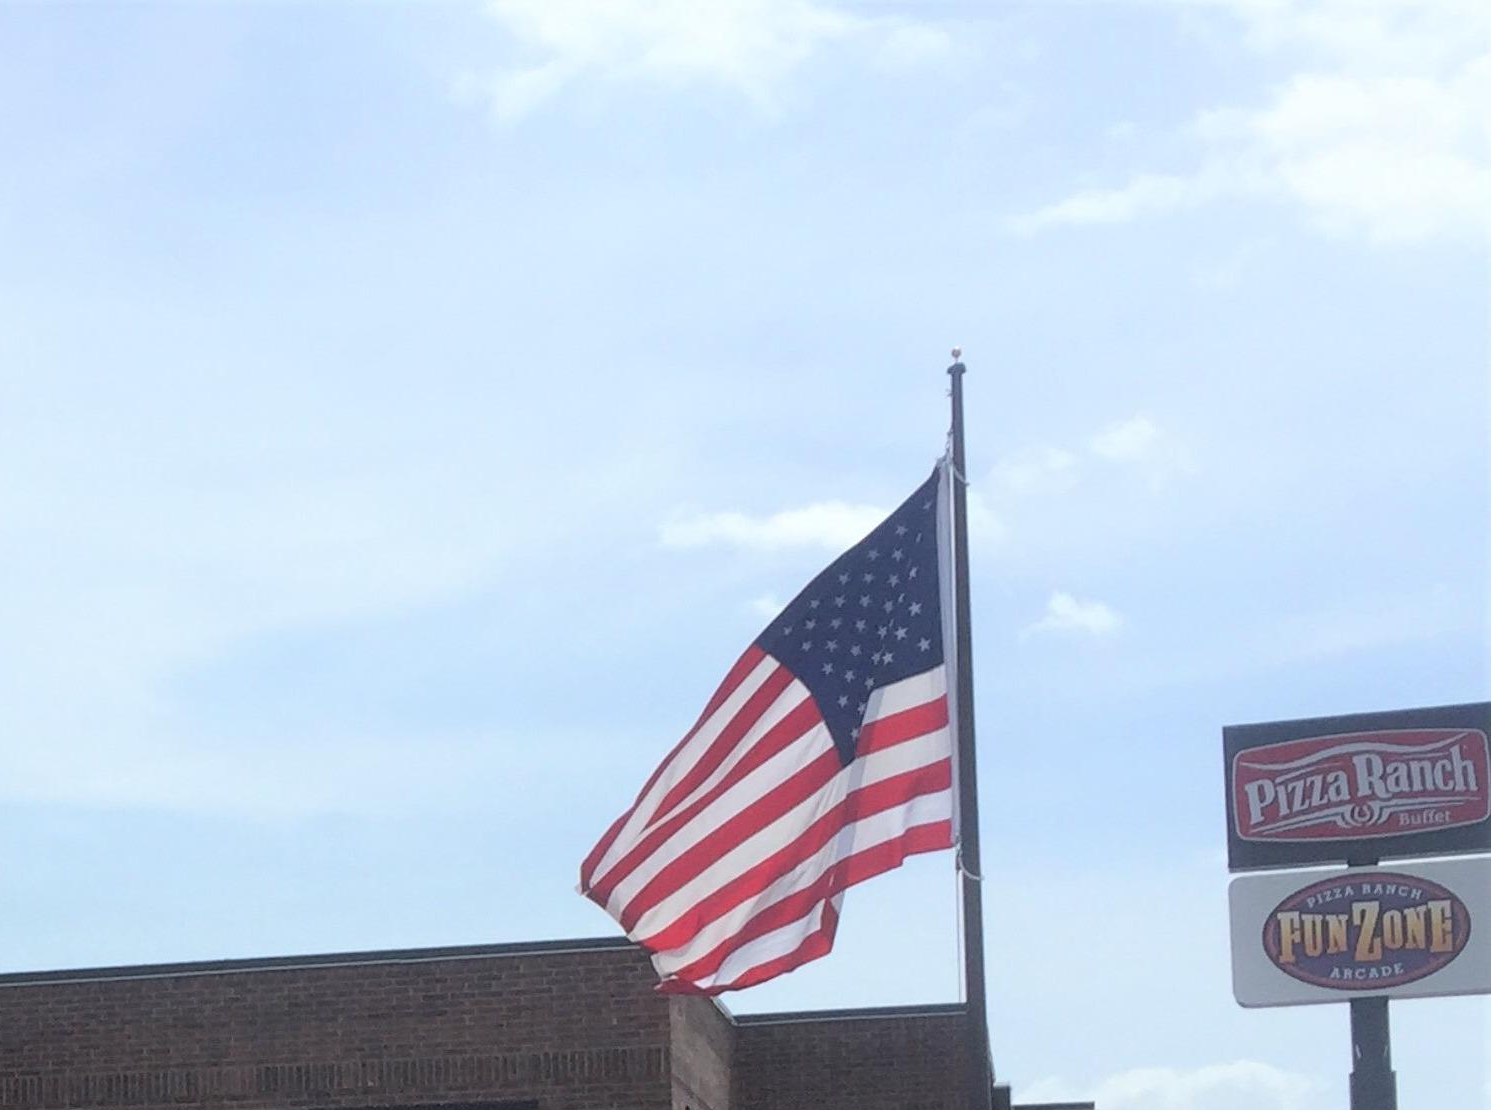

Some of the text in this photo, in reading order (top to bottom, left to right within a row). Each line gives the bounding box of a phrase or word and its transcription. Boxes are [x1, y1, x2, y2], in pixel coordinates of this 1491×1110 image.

[1244, 744, 1479, 825] Pizza Ranch
[1399, 811, 1451, 826] Buffet
[1307, 883, 1422, 908] PIZZA RANCH
[1330, 962, 1405, 979] ARCADE
